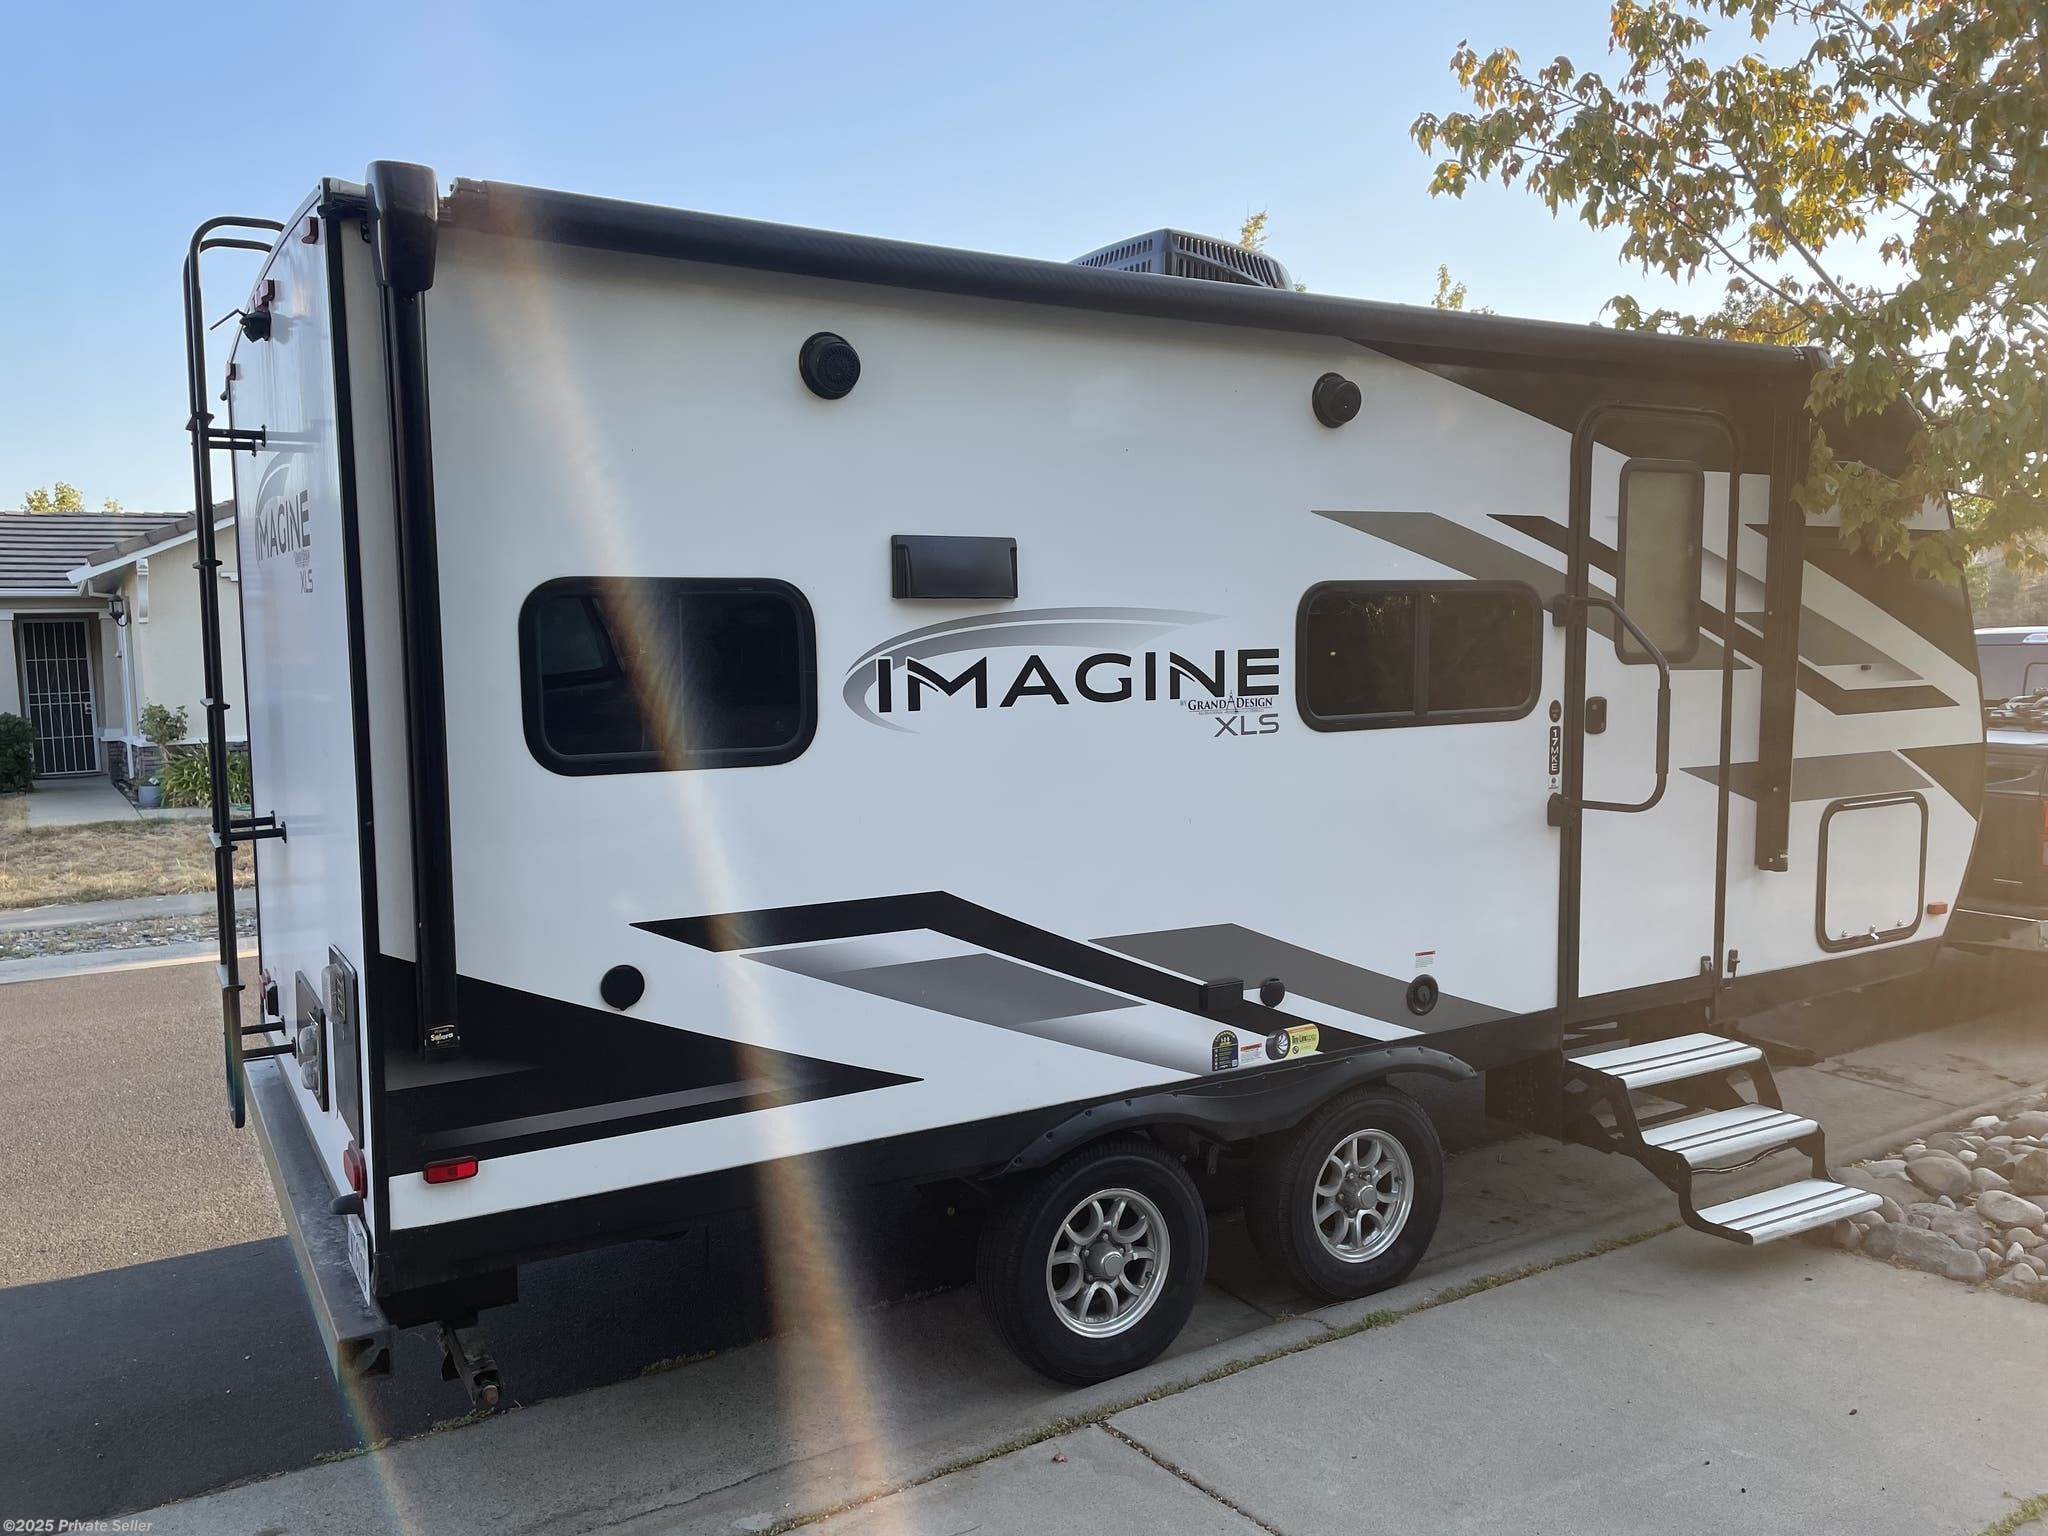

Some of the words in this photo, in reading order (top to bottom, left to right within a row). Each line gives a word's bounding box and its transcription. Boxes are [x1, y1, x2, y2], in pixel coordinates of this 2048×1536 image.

[255, 488, 311, 562] IMAGINE
[299, 569, 314, 594] XLS
[877, 648, 1280, 714] IMAGINE
[1188, 698, 1227, 711] GRAND
[1236, 697, 1273, 709] DESIGN
[1214, 713, 1280, 738] XLS
